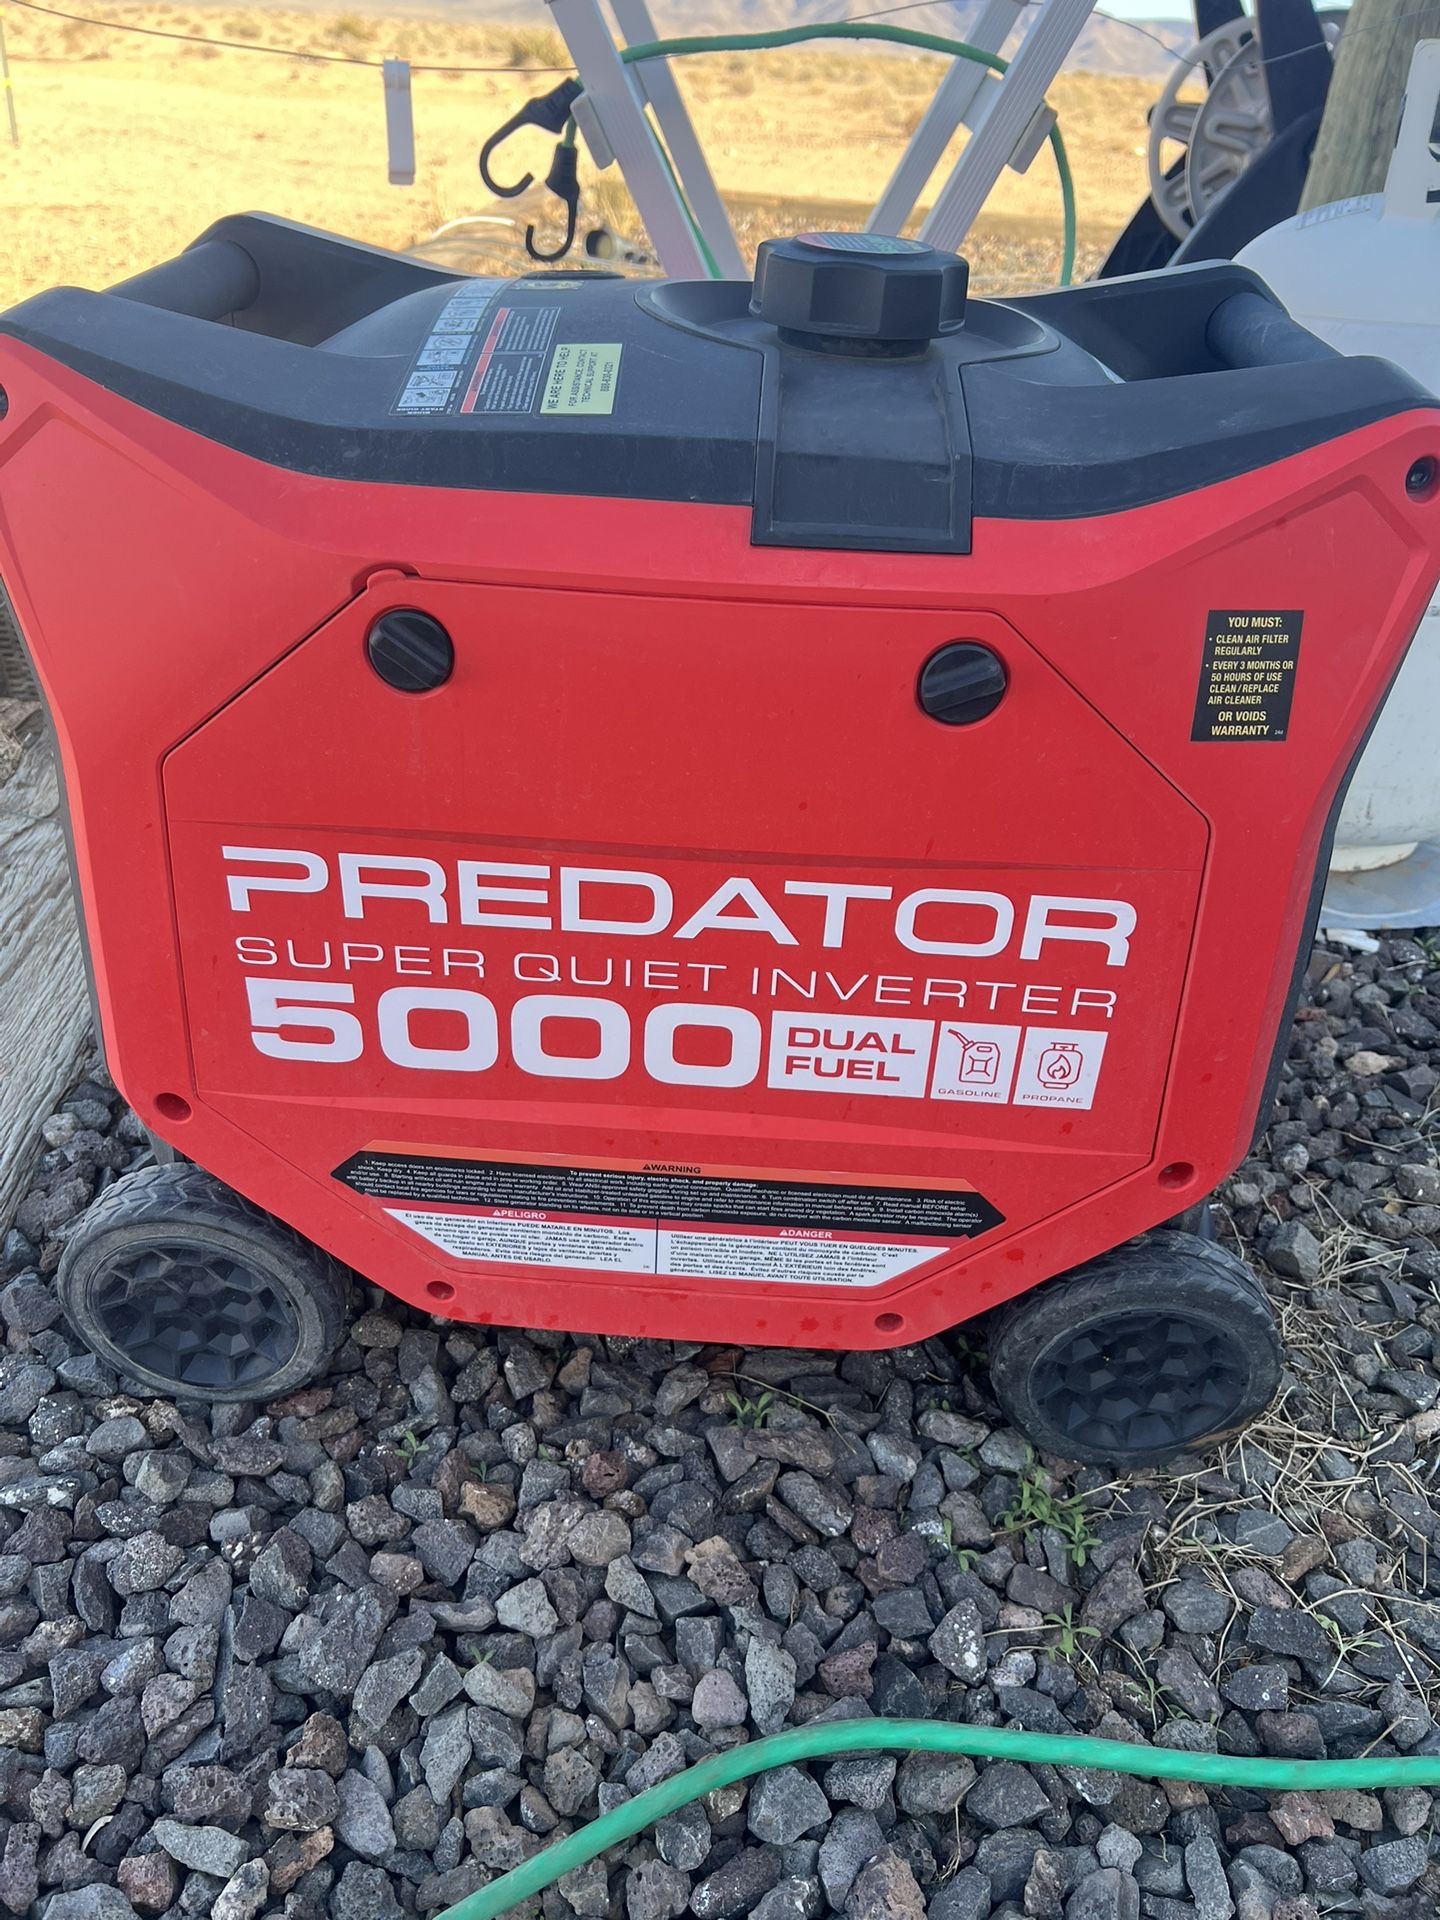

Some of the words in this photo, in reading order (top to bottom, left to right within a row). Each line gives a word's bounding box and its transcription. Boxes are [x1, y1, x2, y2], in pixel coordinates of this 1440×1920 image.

[576, 349, 587, 367] CONTACT
[586, 358, 596, 376] SUPPORT
[553, 369, 566, 384] HERE
[571, 369, 584, 395] ASSISTANCE
[549, 386, 562, 398] ARE
[581, 377, 594, 403] TECHNICAL
[547, 399, 558, 409] WE
[568, 396, 577, 407] FOR
[1228, 617, 1249, 628] YOU
[1251, 617, 1282, 628] MUST:
[1216, 635, 1243, 644] CLEAN
[1245, 635, 1260, 644] AIR
[1262, 635, 1289, 644] FILTER
[1214, 646, 1262, 655] REGULARLY
[1213, 661, 1239, 670] EVERY
[1240, 661, 1245, 670] 3
[1246, 661, 1281, 670] MONTHS
[1282, 661, 1294, 670] OR
[1211, 672, 1222, 681] 50
[1224, 672, 1252, 681] HOURS
[1254, 672, 1265, 681] OF
[1266, 672, 1282, 681] USE
[1208, 696, 1222, 705] AIR
[1224, 696, 1262, 705] CLEANER
[1218, 711, 1232, 721] OR
[1236, 711, 1266, 721] VOIDS
[1211, 725, 1270, 736] WARRANTY
[221, 845, 1137, 966] PREDATOR
[235, 936, 486, 978] SUPER
[513, 952, 727, 992] QUIET
[752, 966, 1117, 1018] INVERTER
[245, 976, 762, 1088] 5000
[788, 1027, 916, 1054] DUAL
[784, 1056, 900, 1082] FUEL
[938, 1088, 1002, 1099] GASOLINE
[1022, 1094, 1083, 1104] PROPANE
[652, 1164, 701, 1174] WARNING
[500, 1210, 546, 1220] PELIGRO
[788, 1229, 832, 1239] DANGER
